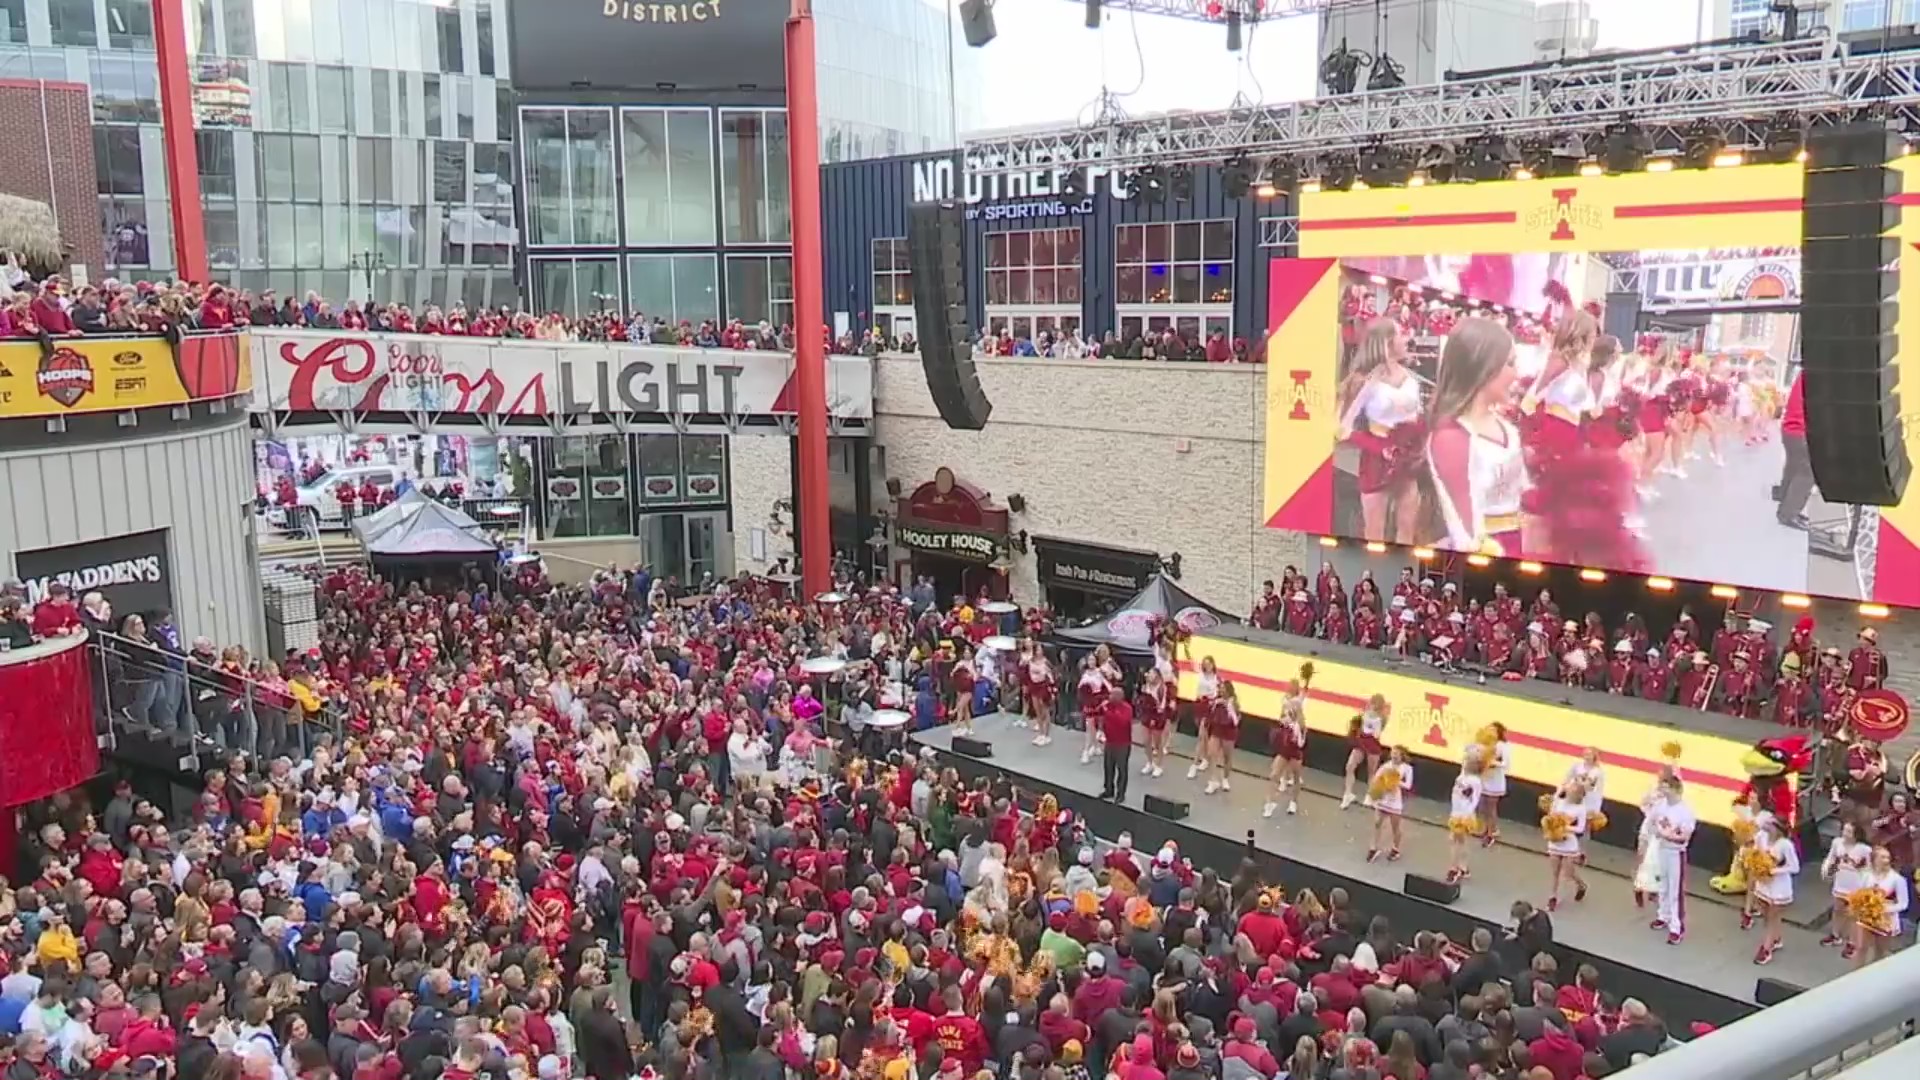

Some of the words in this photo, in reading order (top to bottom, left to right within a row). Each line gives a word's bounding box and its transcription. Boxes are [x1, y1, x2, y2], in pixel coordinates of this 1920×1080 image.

[603, 0, 721, 23] DISTRICT
[913, 158, 954, 203] NO
[984, 202, 1066, 220] SPORTING
[393, 375, 441, 389] LIGHT
[560, 361, 744, 414] LIGHT
[902, 528, 949, 549] HOOLEY
[951, 533, 994, 556] HOUSE
[25, 555, 161, 606] MFADDEN'S
